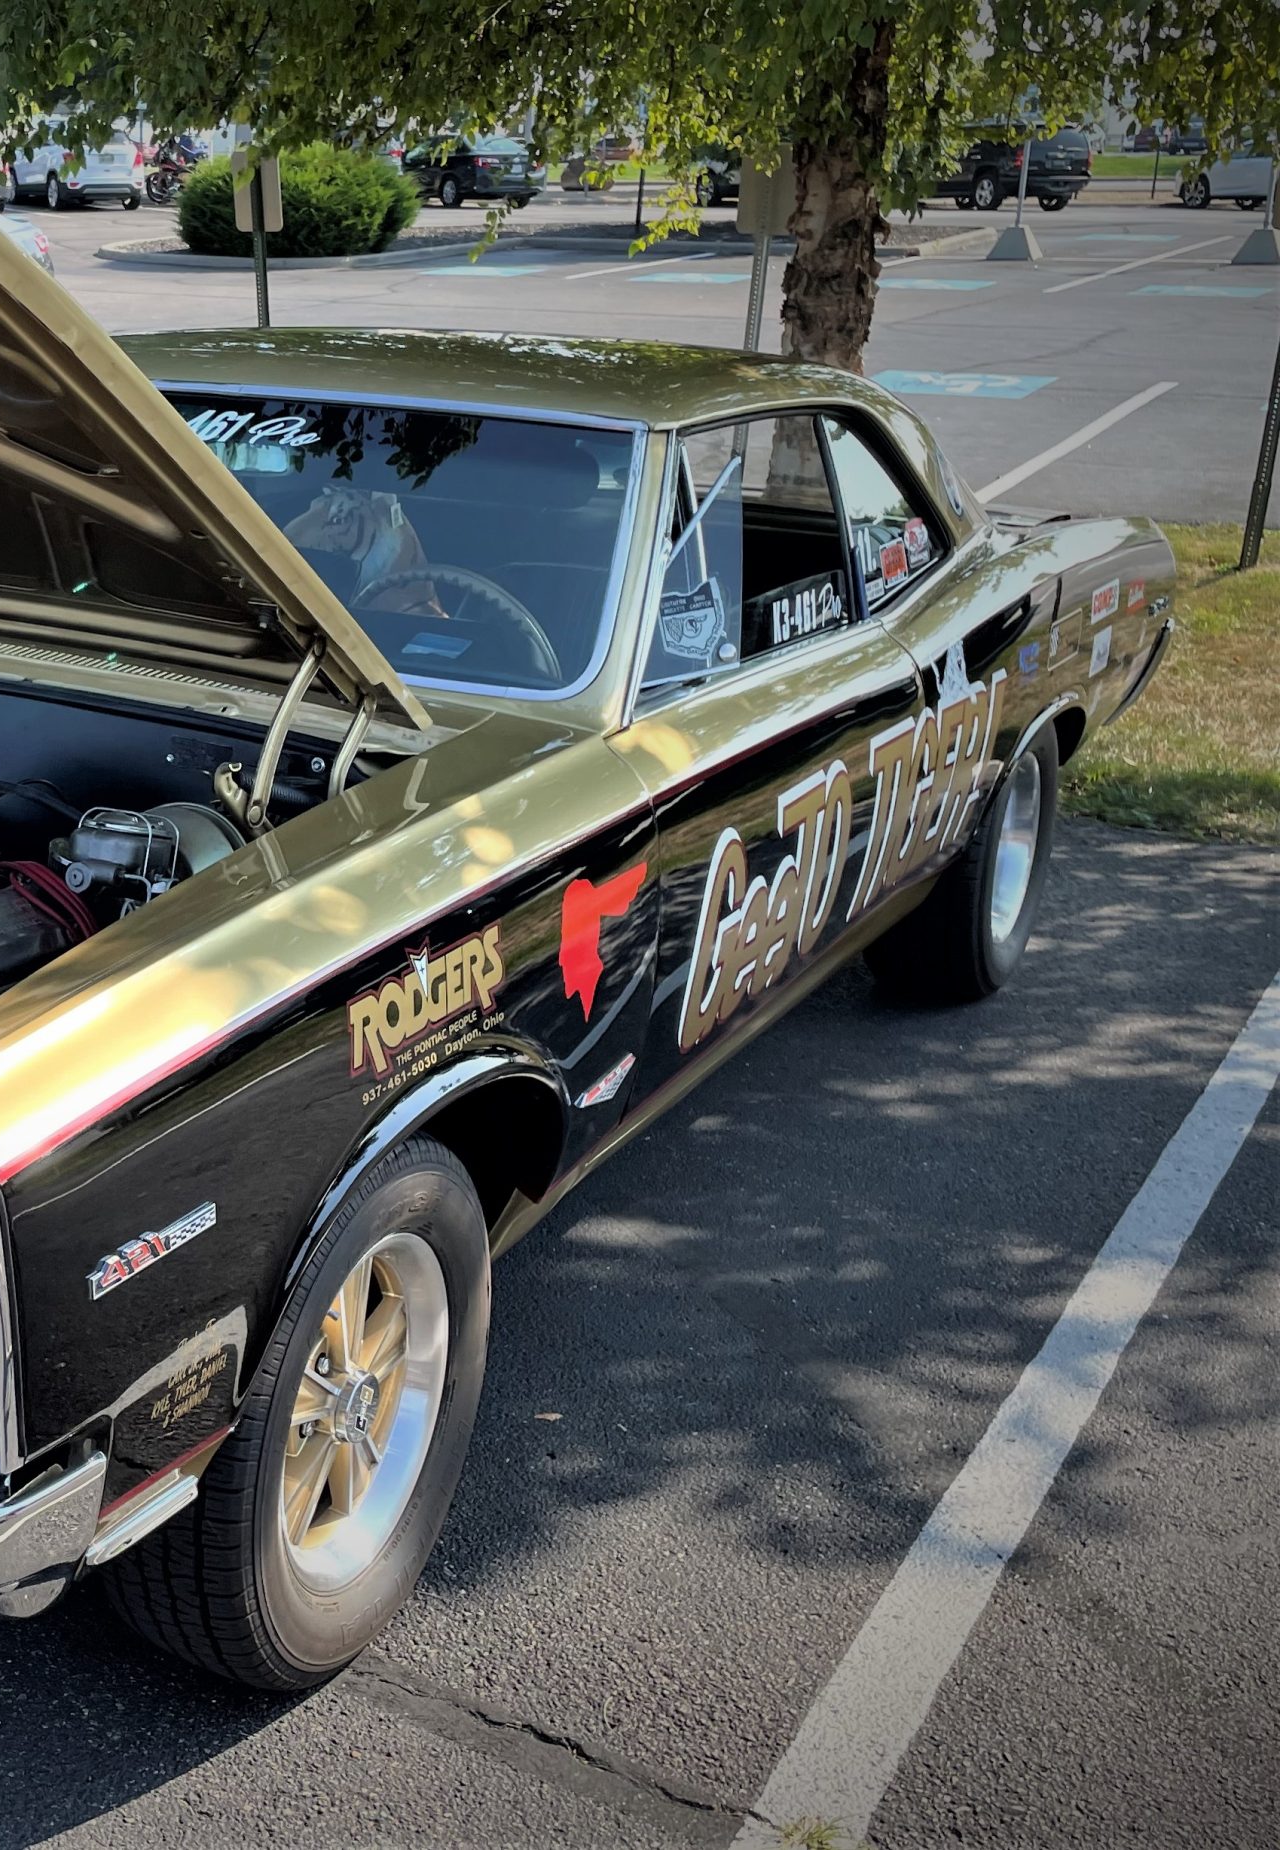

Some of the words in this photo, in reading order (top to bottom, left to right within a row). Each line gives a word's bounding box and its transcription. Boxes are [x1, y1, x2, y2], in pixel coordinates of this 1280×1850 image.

[248, 416, 321, 446] Pro
[772, 588, 817, 644] K3-461
[819, 582, 842, 627] Pro
[348, 923, 503, 1075] RODGERS
[362, 1052, 438, 1105] 937-461-5030
[445, 1027, 482, 1055] Dayton,
[483, 1012, 505, 1031] Ohio
[396, 1049, 412, 1066] THE
[414, 1028, 448, 1057] PONTIAC
[448, 1010, 478, 1036] PEOPLE
[99, 1231, 167, 1288] 421
